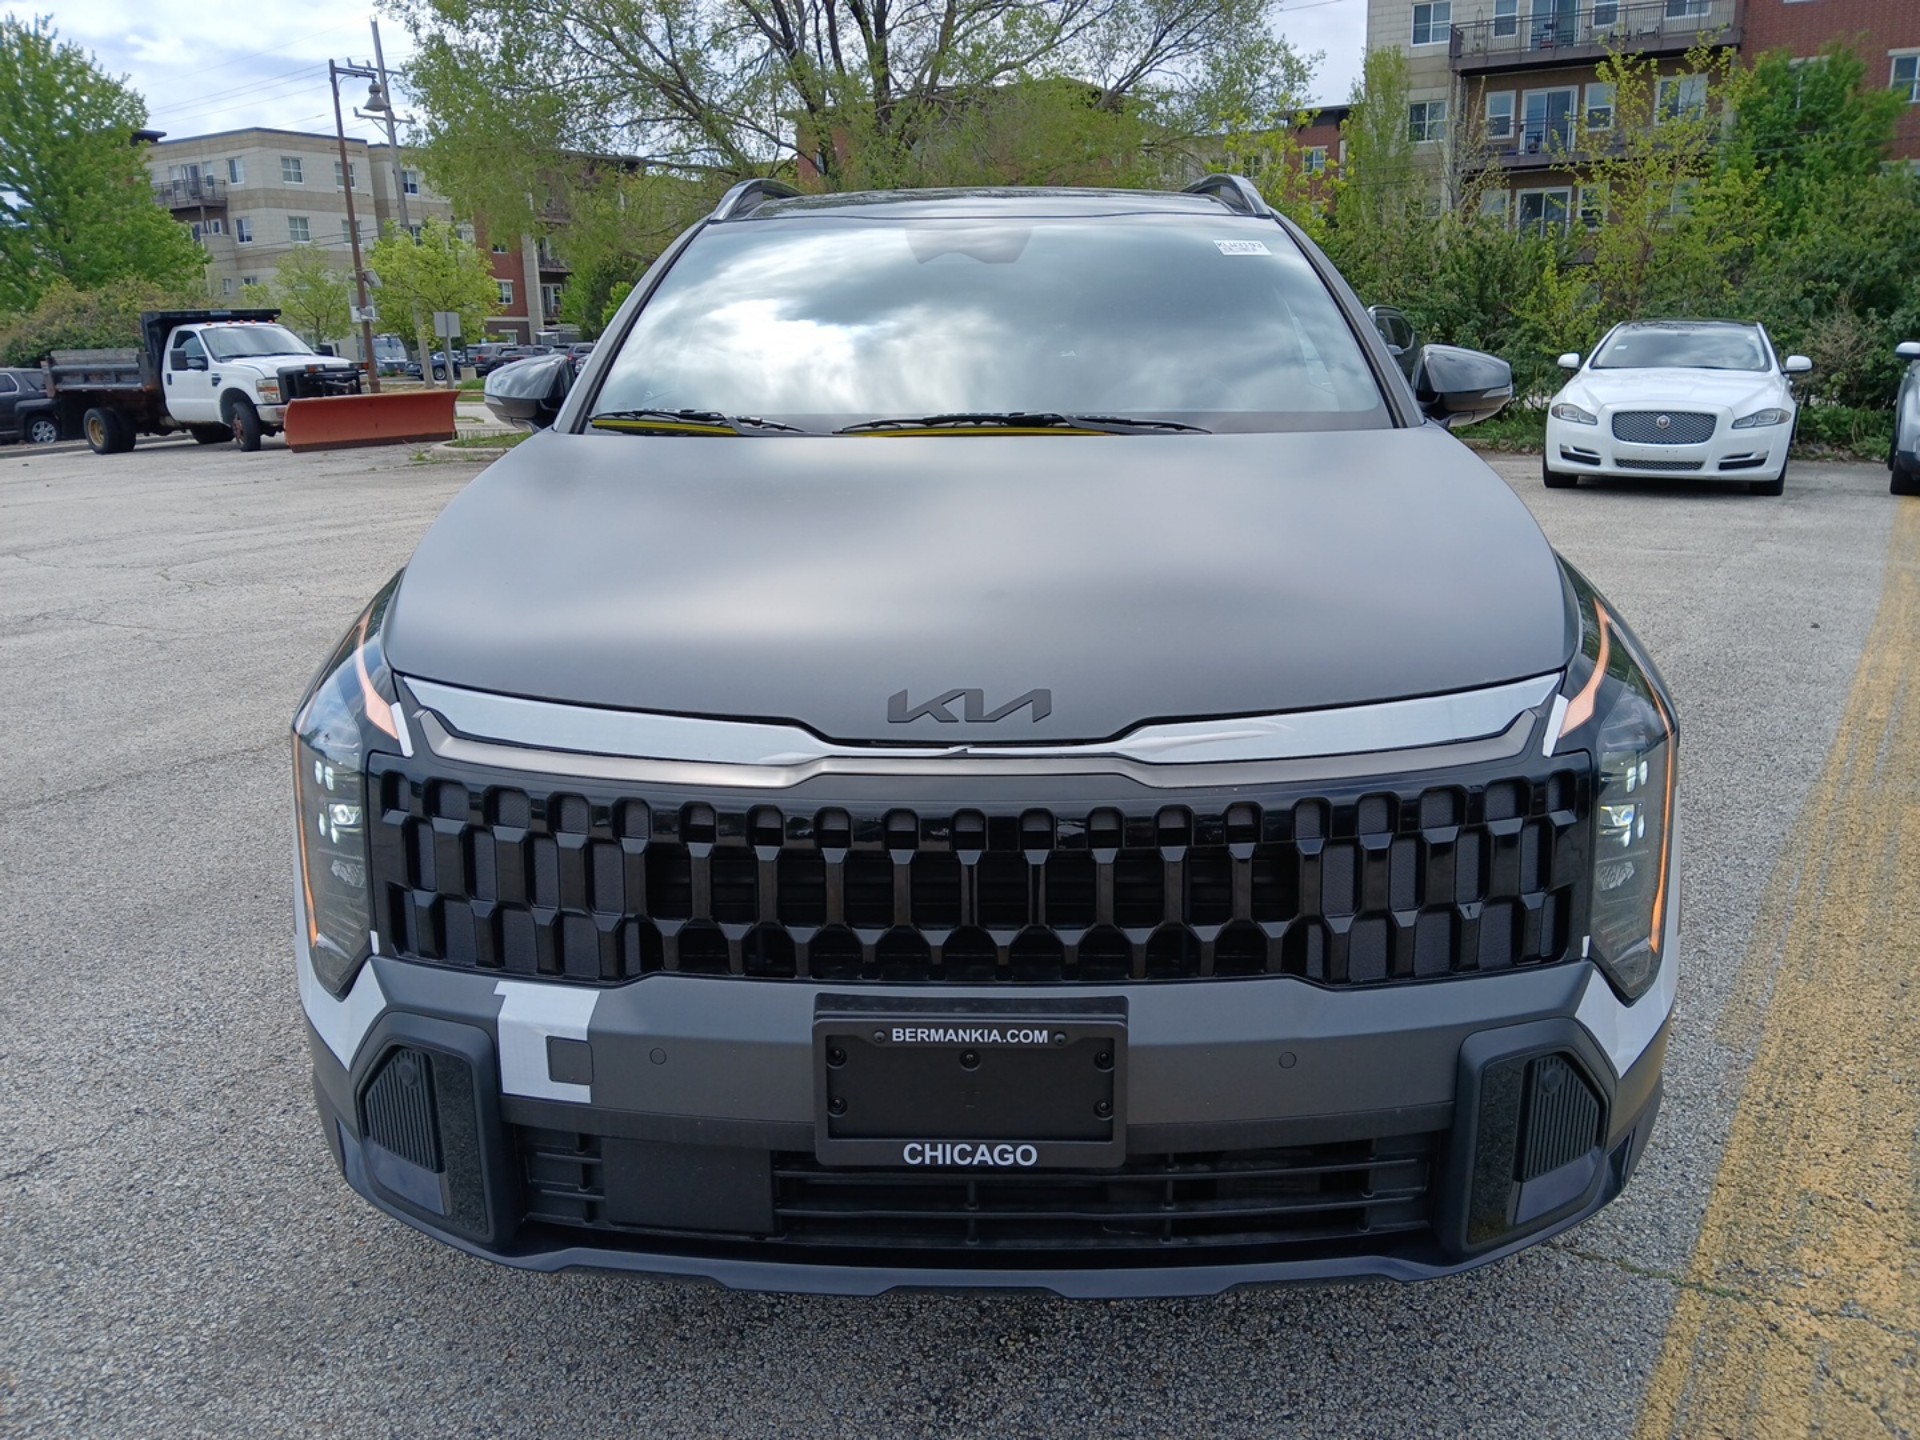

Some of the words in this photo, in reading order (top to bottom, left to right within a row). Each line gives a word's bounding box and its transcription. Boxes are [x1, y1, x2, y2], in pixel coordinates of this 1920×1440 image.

[888, 688, 1052, 723] KIA
[892, 1028, 1048, 1044] BERMANKIA.COM
[903, 1143, 1038, 1166] CHICAGO
